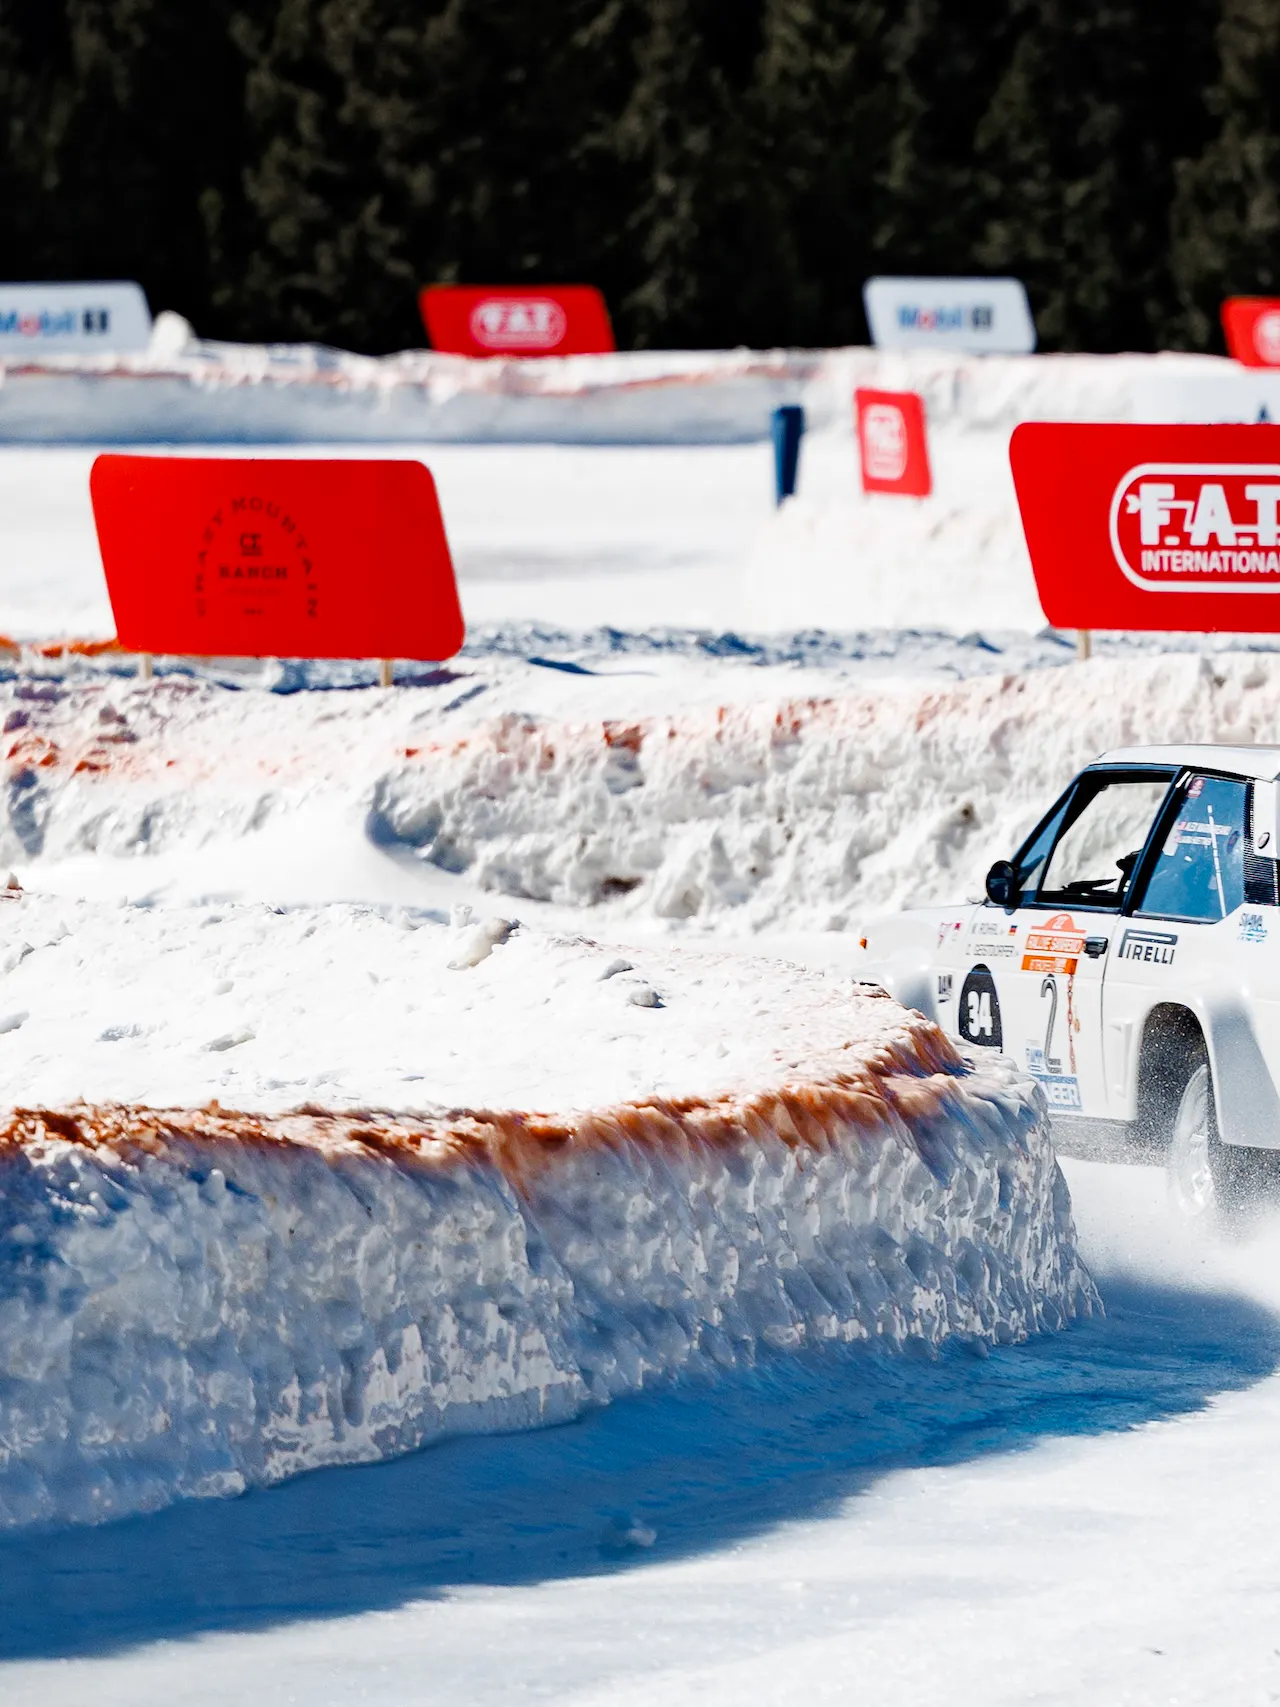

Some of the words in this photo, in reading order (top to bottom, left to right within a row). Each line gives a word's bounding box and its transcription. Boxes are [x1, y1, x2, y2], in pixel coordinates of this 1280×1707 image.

[219, 565, 288, 579] RANCH
[1118, 929, 1178, 965] PIRELLI
[967, 990, 992, 1037] 34
